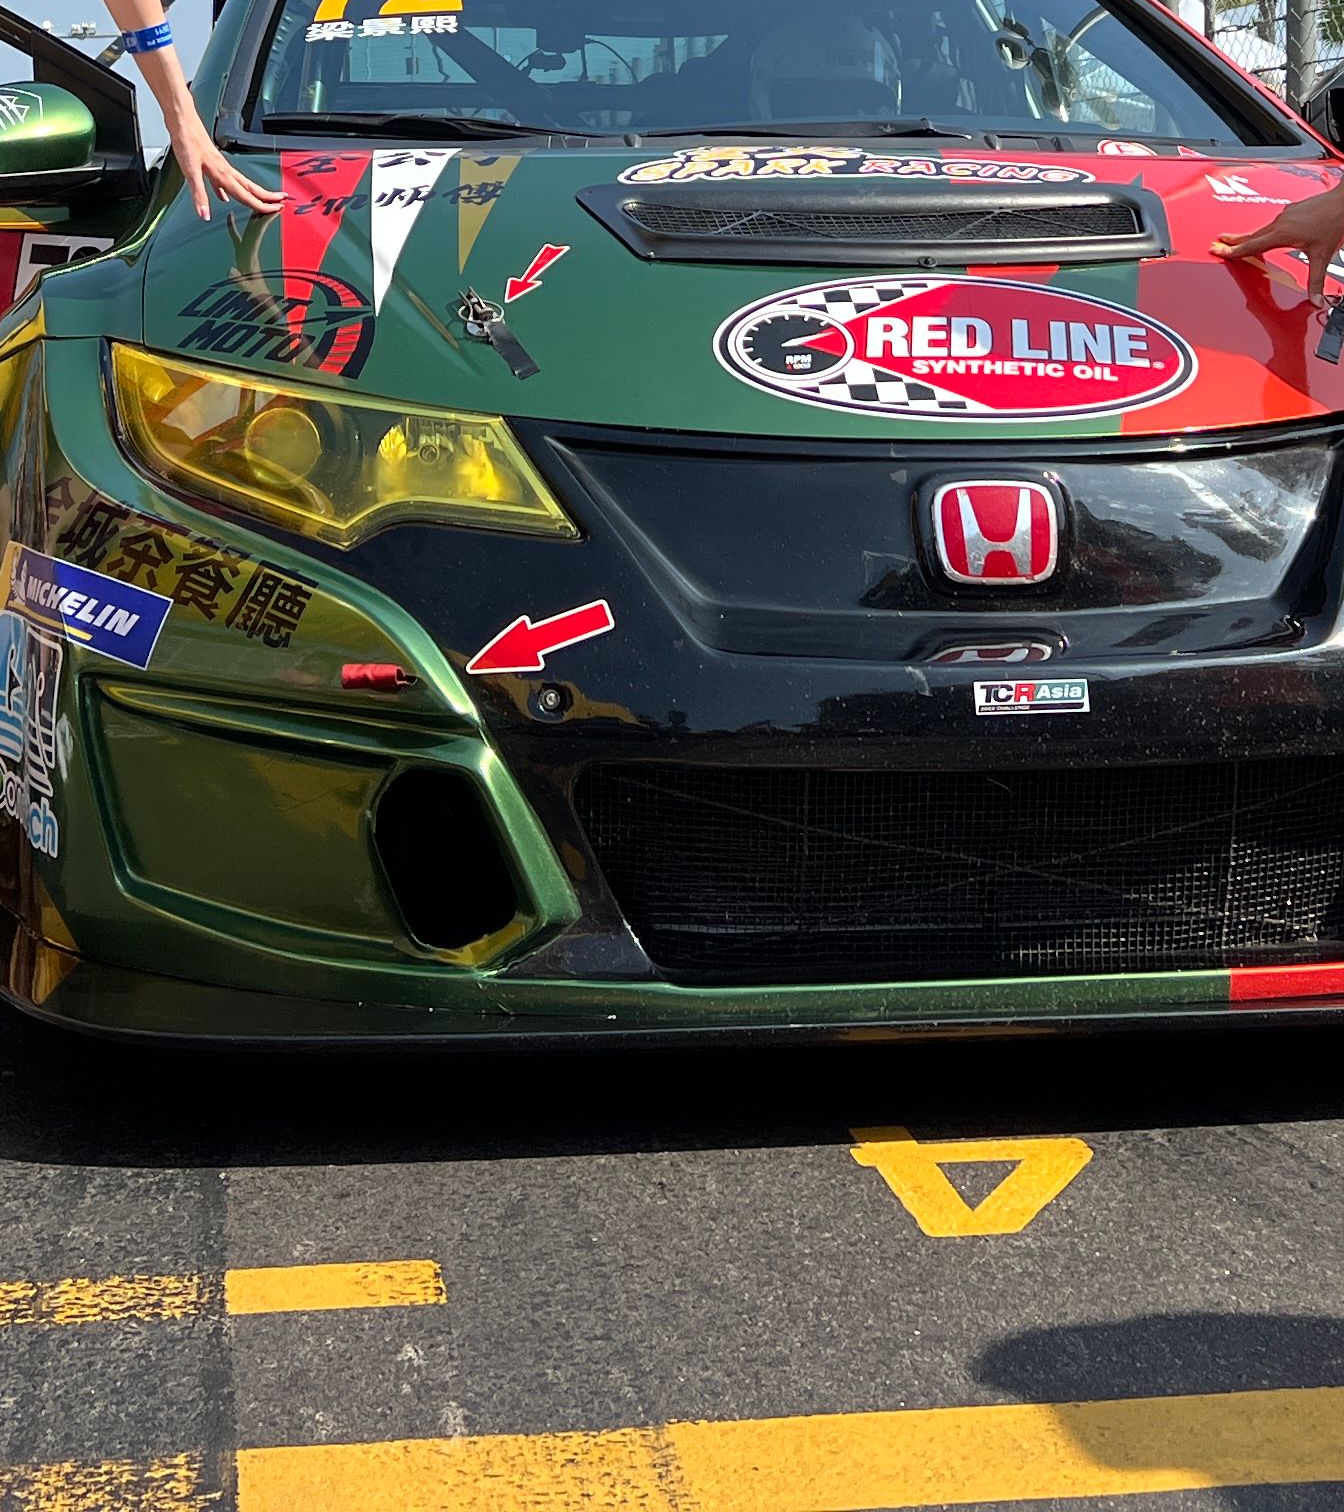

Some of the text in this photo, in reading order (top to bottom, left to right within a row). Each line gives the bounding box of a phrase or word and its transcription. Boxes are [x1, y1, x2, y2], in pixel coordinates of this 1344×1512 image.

[305, 15, 460, 43] 梁景熙
[631, 159, 1080, 183] SPARK RACING
[866, 316, 1150, 369] RED LINE
[912, 359, 1119, 382] SYNTHETIC OIL
[26, 575, 140, 638] MICHELIN
[980, 683, 1083, 704] TCR Asia
